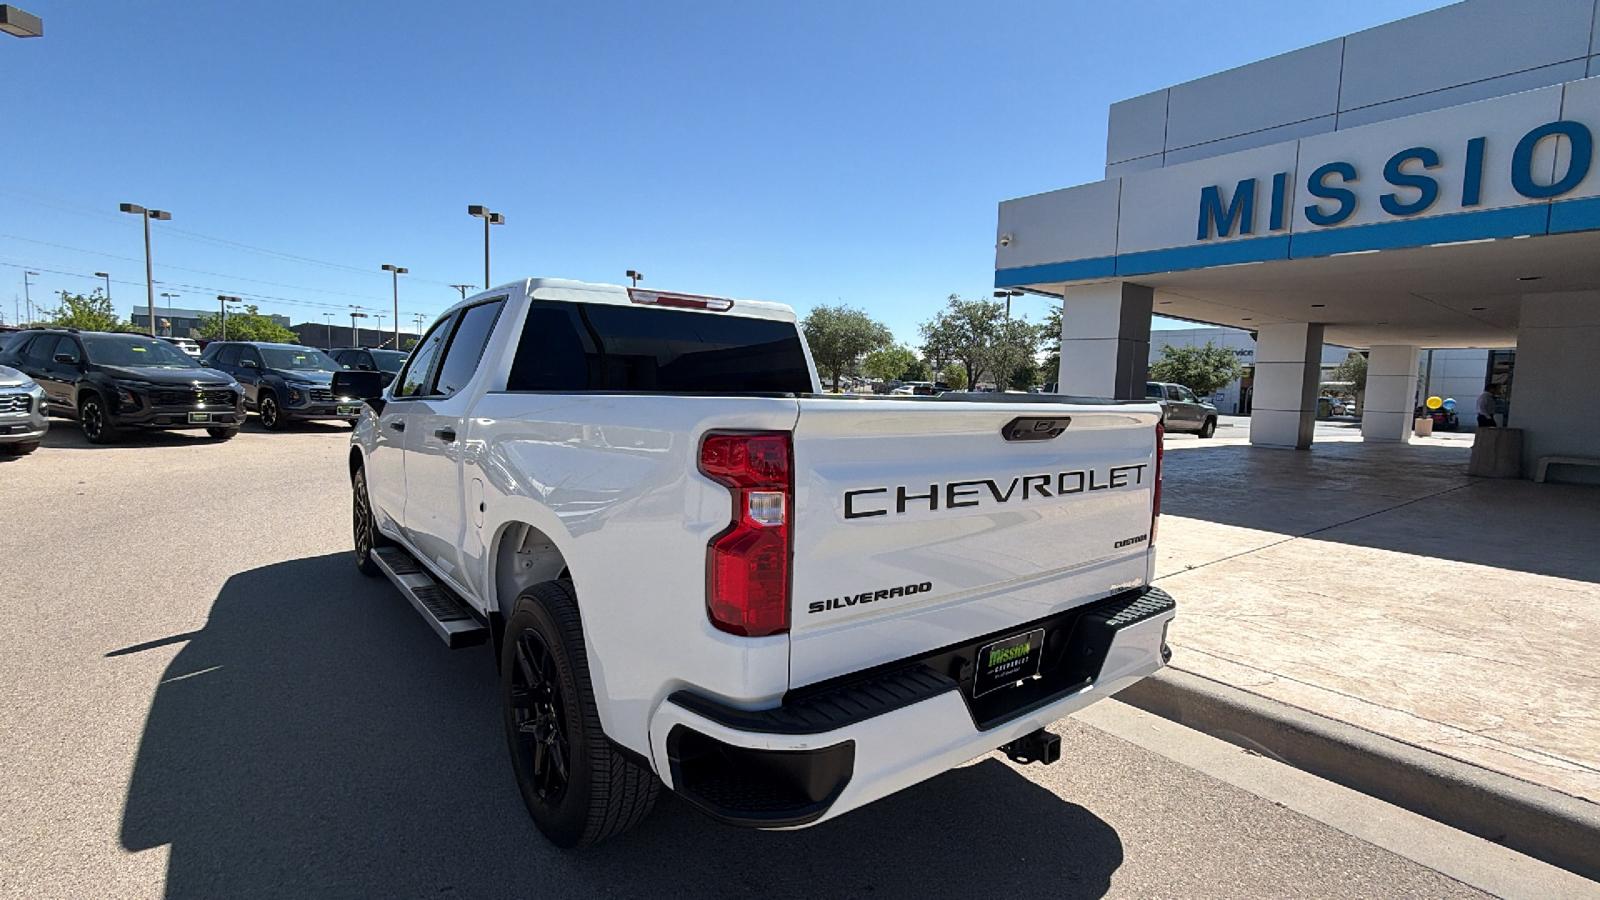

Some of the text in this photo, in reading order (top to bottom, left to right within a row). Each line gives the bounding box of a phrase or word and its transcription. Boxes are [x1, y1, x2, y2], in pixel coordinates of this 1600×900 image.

[1197, 120, 1593, 240] MISSIO
[844, 464, 1148, 520] CHEVROLET
[1114, 533, 1148, 549] CUSTOM
[808, 581, 933, 614] SILVERADO
